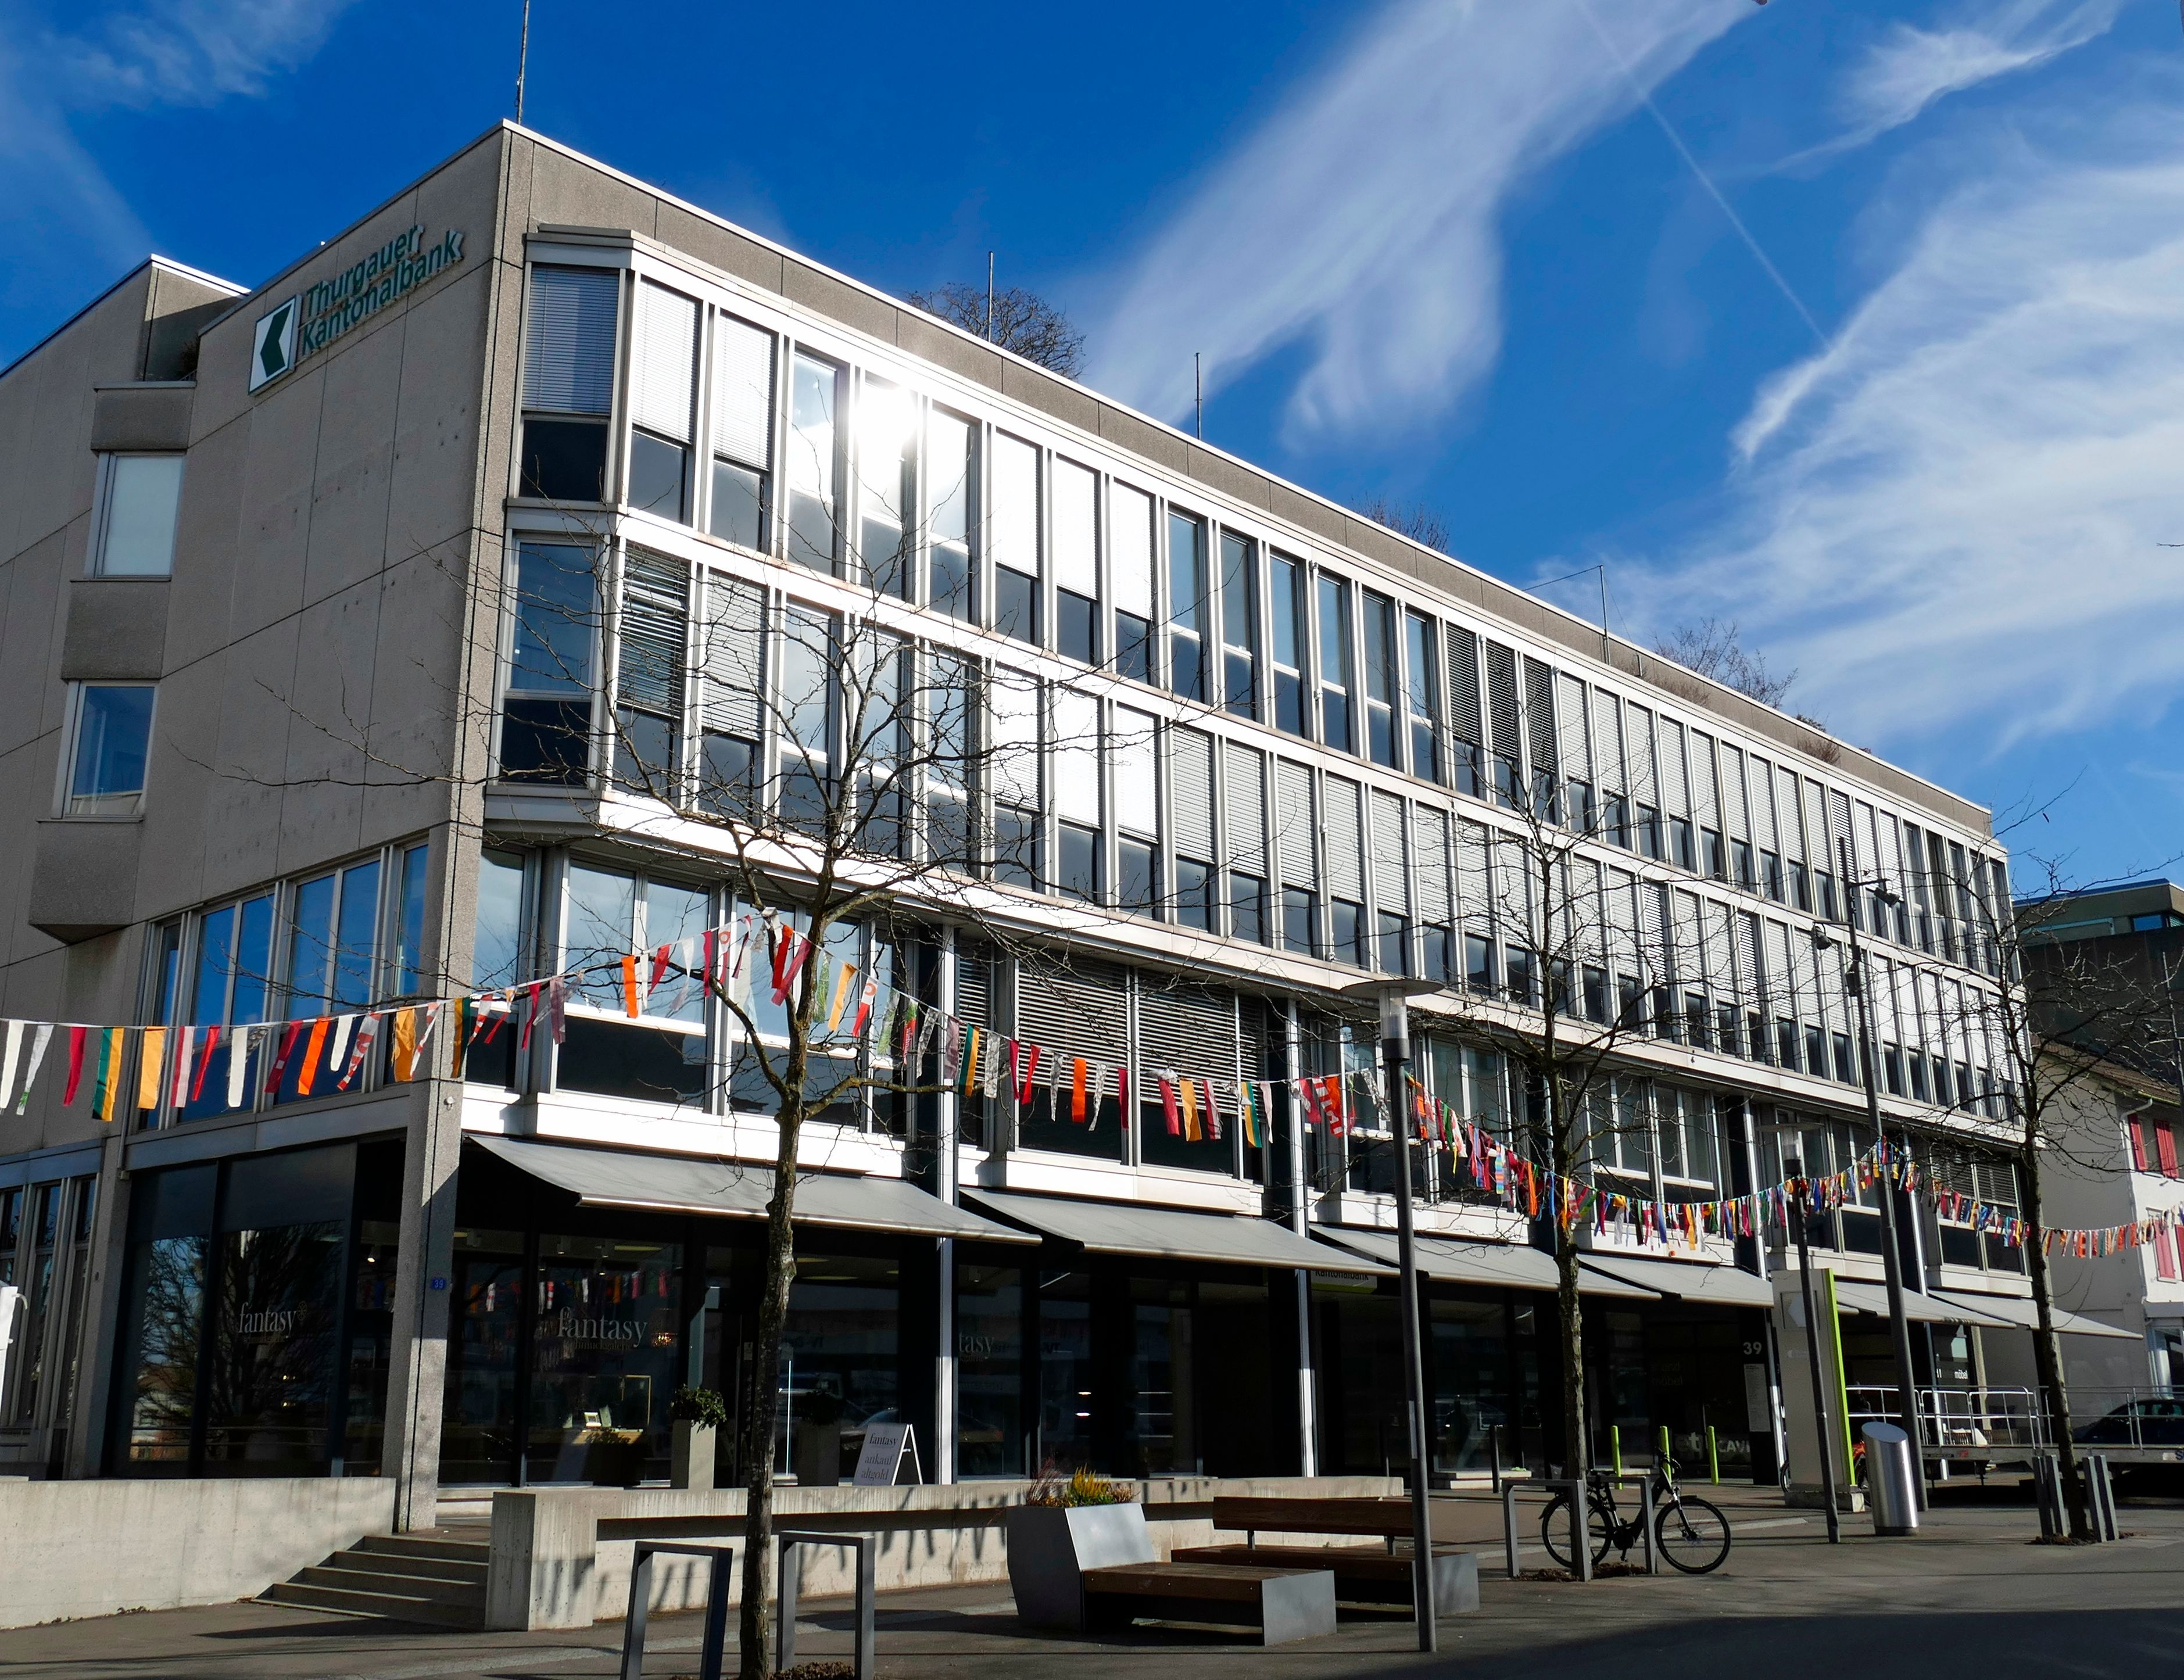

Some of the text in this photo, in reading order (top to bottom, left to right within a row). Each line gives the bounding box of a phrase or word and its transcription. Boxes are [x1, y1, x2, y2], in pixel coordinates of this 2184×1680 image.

[307, 224, 424, 317] Thurgauer
[303, 228, 463, 356] Kantonalbank
[434, 1279, 443, 1288] 39
[238, 1302, 297, 1339] fantasy
[557, 1306, 648, 1348] fantasy
[958, 1331, 995, 1360] tasy
[1743, 1341, 1763, 1355] 39
[869, 1432, 898, 1446] fantasy
[864, 1453, 894, 1465] ankauf
[861, 1467, 890, 1481] altgold
